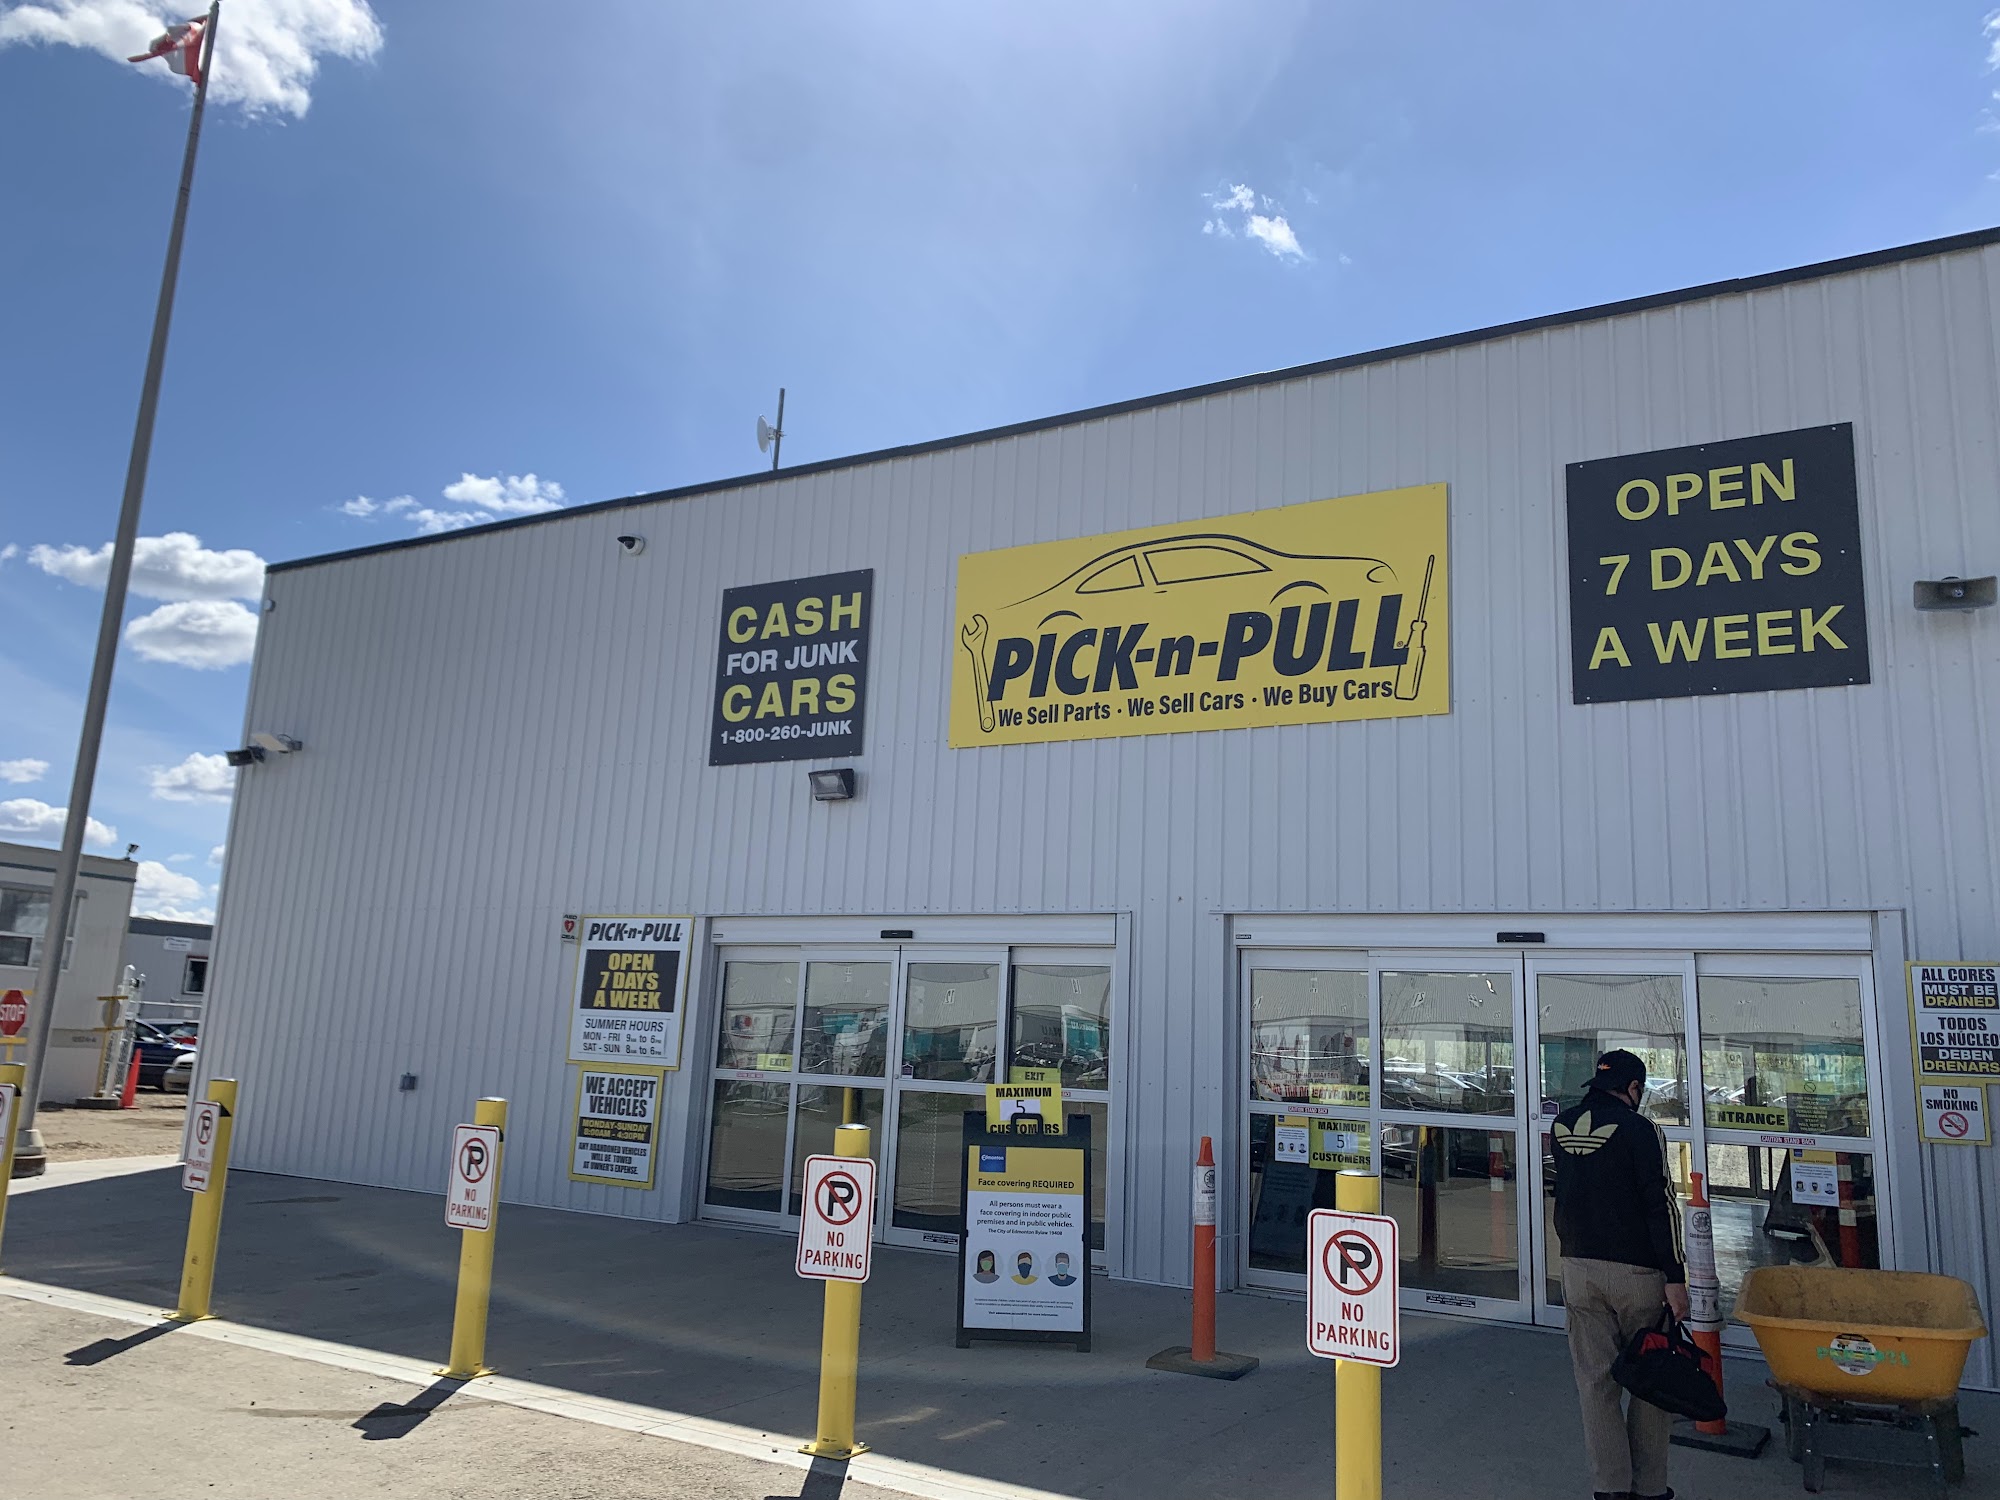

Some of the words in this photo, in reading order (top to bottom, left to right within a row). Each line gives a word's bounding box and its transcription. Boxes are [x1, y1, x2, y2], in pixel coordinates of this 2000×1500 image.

[1616, 458, 1796, 520] OPEN
[1600, 554, 1630, 595] 7
[1650, 531, 1822, 591] DAYS
[727, 592, 862, 643] CASH
[1588, 626, 1632, 670] A
[1646, 605, 1849, 664] WEEK
[986, 594, 1409, 702] PICK-n-PULL
[726, 649, 778, 676] FOR
[784, 640, 859, 670] JUNK
[722, 674, 856, 722] CARS
[998, 708, 1024, 728] We
[1026, 704, 1059, 726] Sell
[1063, 702, 1111, 723] Parts
[1127, 698, 1157, 718] We
[1159, 694, 1194, 715] Sell
[1199, 691, 1245, 712] Cars
[1262, 686, 1294, 707] We
[1299, 682, 1337, 710] Buy
[1342, 678, 1393, 701] Cars
[721, 720, 852, 744] 1-800-260-JUNK
[588, 922, 681, 942] PICK-n-PULL
[608, 953, 655, 971] OPEN
[600, 971, 610, 988] 7
[612, 971, 659, 990] DAYS
[1921, 968, 1946, 982] ALL
[1948, 968, 1995, 982] CORES
[1924, 984, 1969, 996] MUST
[1973, 985, 1996, 996] BE
[593, 990, 606, 1008] A
[610, 990, 661, 1010] WEEK
[1925, 996, 1996, 1008] DRAINED
[0, 1003, 25, 1021] STOP
[584, 1018, 627, 1030] SUMMER
[630, 1020, 664, 1032] HOURS
[1938, 1016, 1987, 1031] TODOS
[583, 1031, 602, 1041] MON
[608, 1032, 620, 1042] FRI
[639, 1034, 647, 1043] to
[1920, 1032, 1944, 1046] LOS
[1947, 1031, 2000, 1047] NÚCLEO
[583, 1042, 597, 1051] SAT
[603, 1044, 620, 1053] SUN
[639, 1045, 647, 1054] to
[1938, 1049, 1994, 1061] DEBEN
[1024, 1071, 1045, 1082] EXIT
[585, 1076, 606, 1095] WE
[607, 1077, 656, 1099] ACCEPT
[995, 1087, 1052, 1098] MAXIMUM
[1943, 1088, 1958, 1099] NO
[589, 1095, 648, 1118] VEHICLES
[1926, 1099, 1979, 1111] SMOKING
[582, 1119, 648, 1133] MONDAY-SUNDAY
[990, 1123, 1060, 1134] CUSTOMRS
[1318, 1121, 1366, 1133] MAXIMUM
[1336, 1134, 1345, 1149] 5
[591, 1153, 604, 1162] WILL
[604, 1154, 611, 1162] BE
[613, 1155, 632, 1165] TOWED
[621, 1146, 647, 1157] VEHICLES
[981, 1154, 1004, 1162] Edmonton
[1312, 1152, 1370, 1166] CUSTOMERS
[978, 1178, 995, 1187] Face
[997, 1180, 1031, 1189] covering
[1032, 1181, 1075, 1189] REQUIRED
[464, 1188, 477, 1201] NO
[451, 1203, 487, 1220] PARKING
[999, 1202, 1024, 1210] persons
[993, 1210, 1021, 1218] covering
[1029, 1210, 1050, 1218] indoor
[1051, 1211, 1071, 1220] public
[976, 1218, 1005, 1227] premises
[1005, 1218, 1018, 1226] and
[1026, 1219, 1046, 1228] public
[1047, 1220, 1074, 1228] vehicles.
[826, 1231, 845, 1247] NO
[804, 1249, 863, 1269] PARKING
[1341, 1301, 1364, 1322] NO
[1316, 1322, 1390, 1350] PARKING
